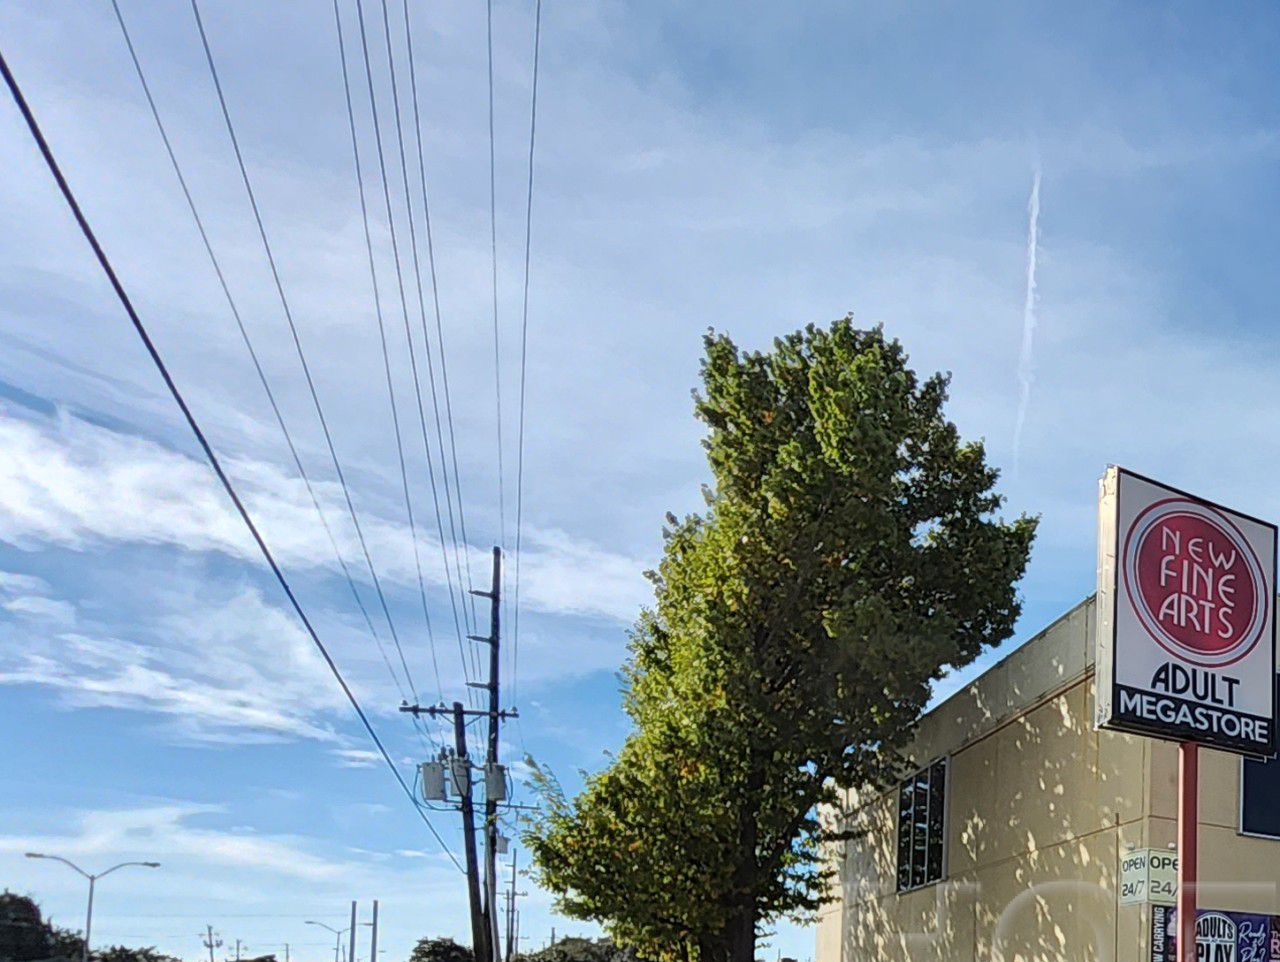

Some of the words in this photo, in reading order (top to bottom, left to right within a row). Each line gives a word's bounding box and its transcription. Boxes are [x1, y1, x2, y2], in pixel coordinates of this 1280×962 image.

[1161, 525, 1236, 571] NEW
[1160, 555, 1236, 608] FINE
[1158, 592, 1234, 639] ARTS
[1151, 662, 1240, 707] ADULT
[1119, 690, 1269, 744] MEGASTORE
[1122, 855, 1146, 873] OPEN
[1149, 855, 1178, 872] OPE
[1122, 880, 1145, 897] 24/7
[1150, 879, 1178, 897] 24/
[1153, 907, 1165, 952] CARRYING
[1196, 917, 1234, 940] ADULTS
